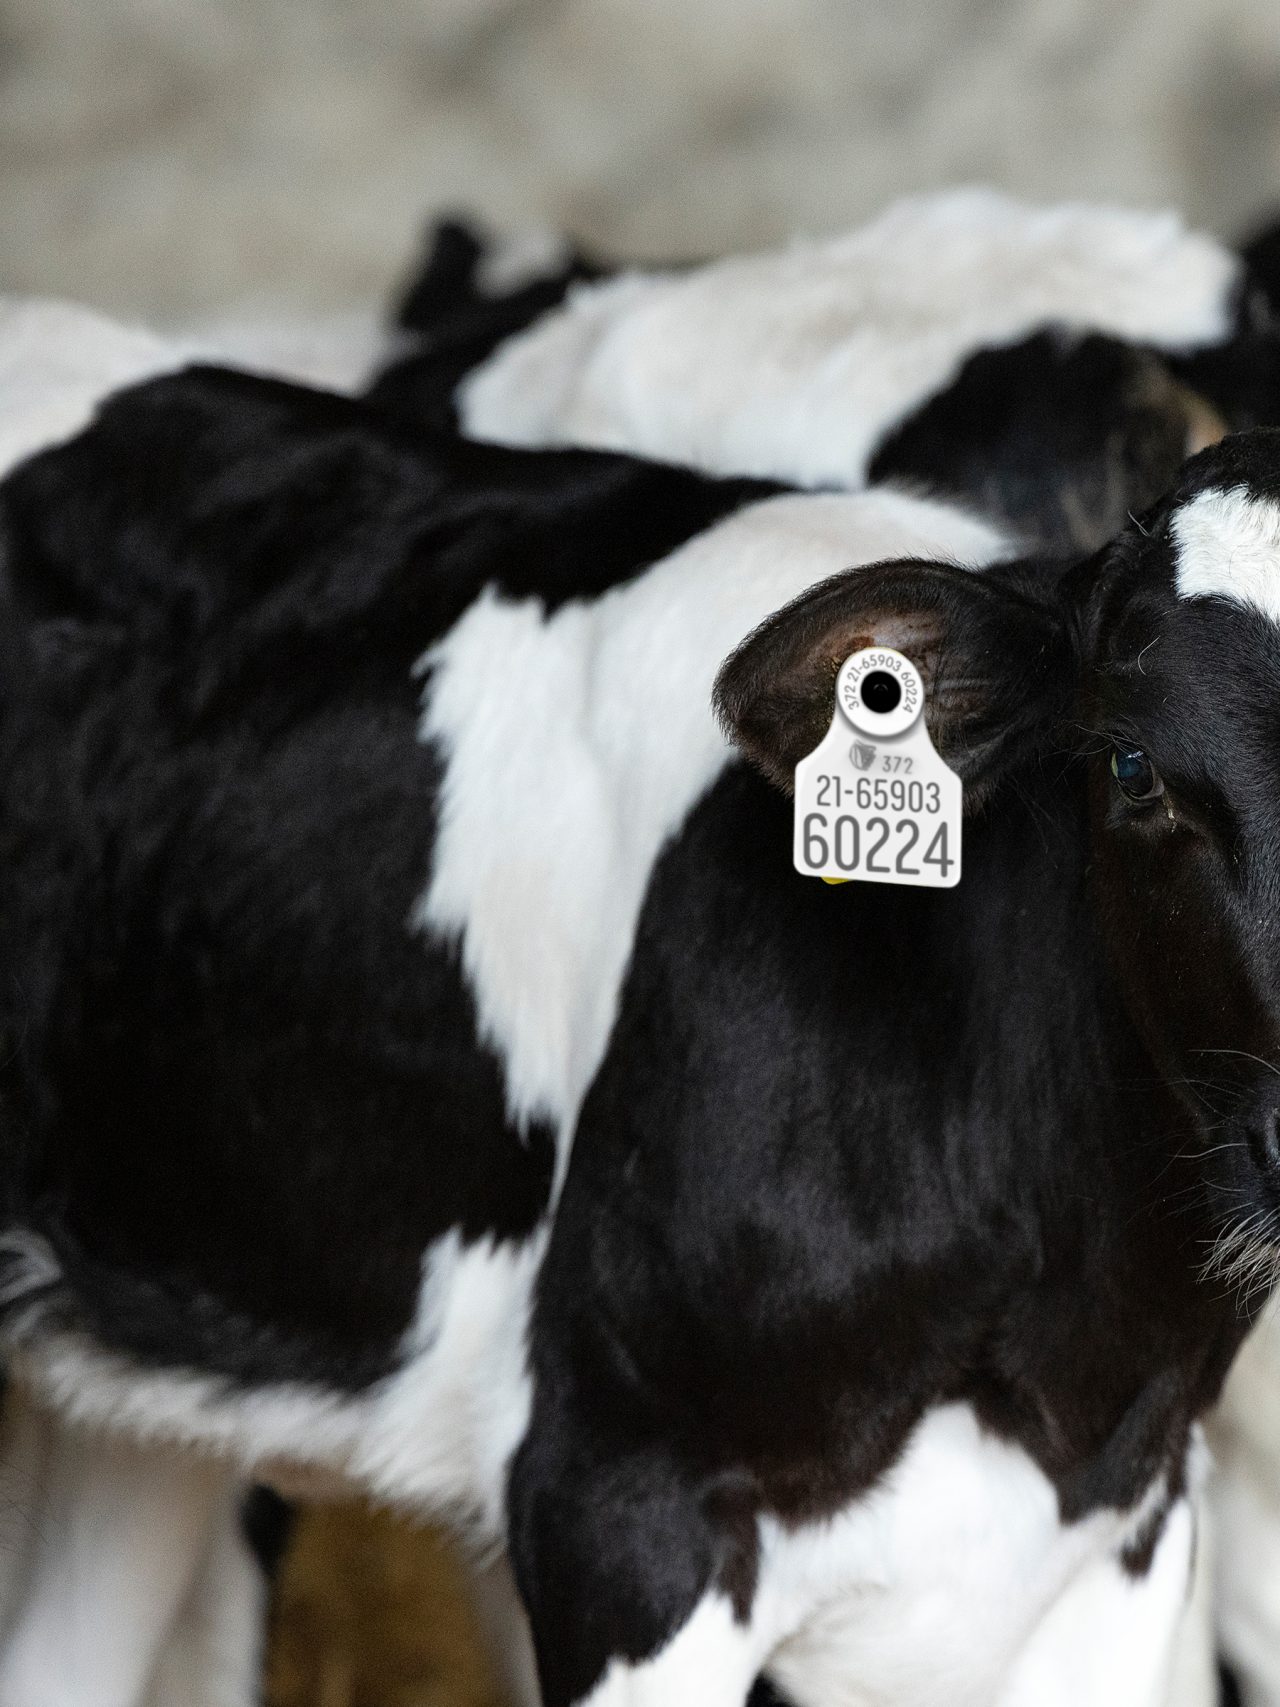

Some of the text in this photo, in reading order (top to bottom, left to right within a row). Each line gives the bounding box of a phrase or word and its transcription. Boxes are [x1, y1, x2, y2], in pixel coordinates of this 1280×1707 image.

[844, 654, 917, 714] 372 21-65903 60224
[882, 755, 914, 775] 372
[816, 774, 941, 814] 21-65903
[803, 812, 955, 878] 60224
